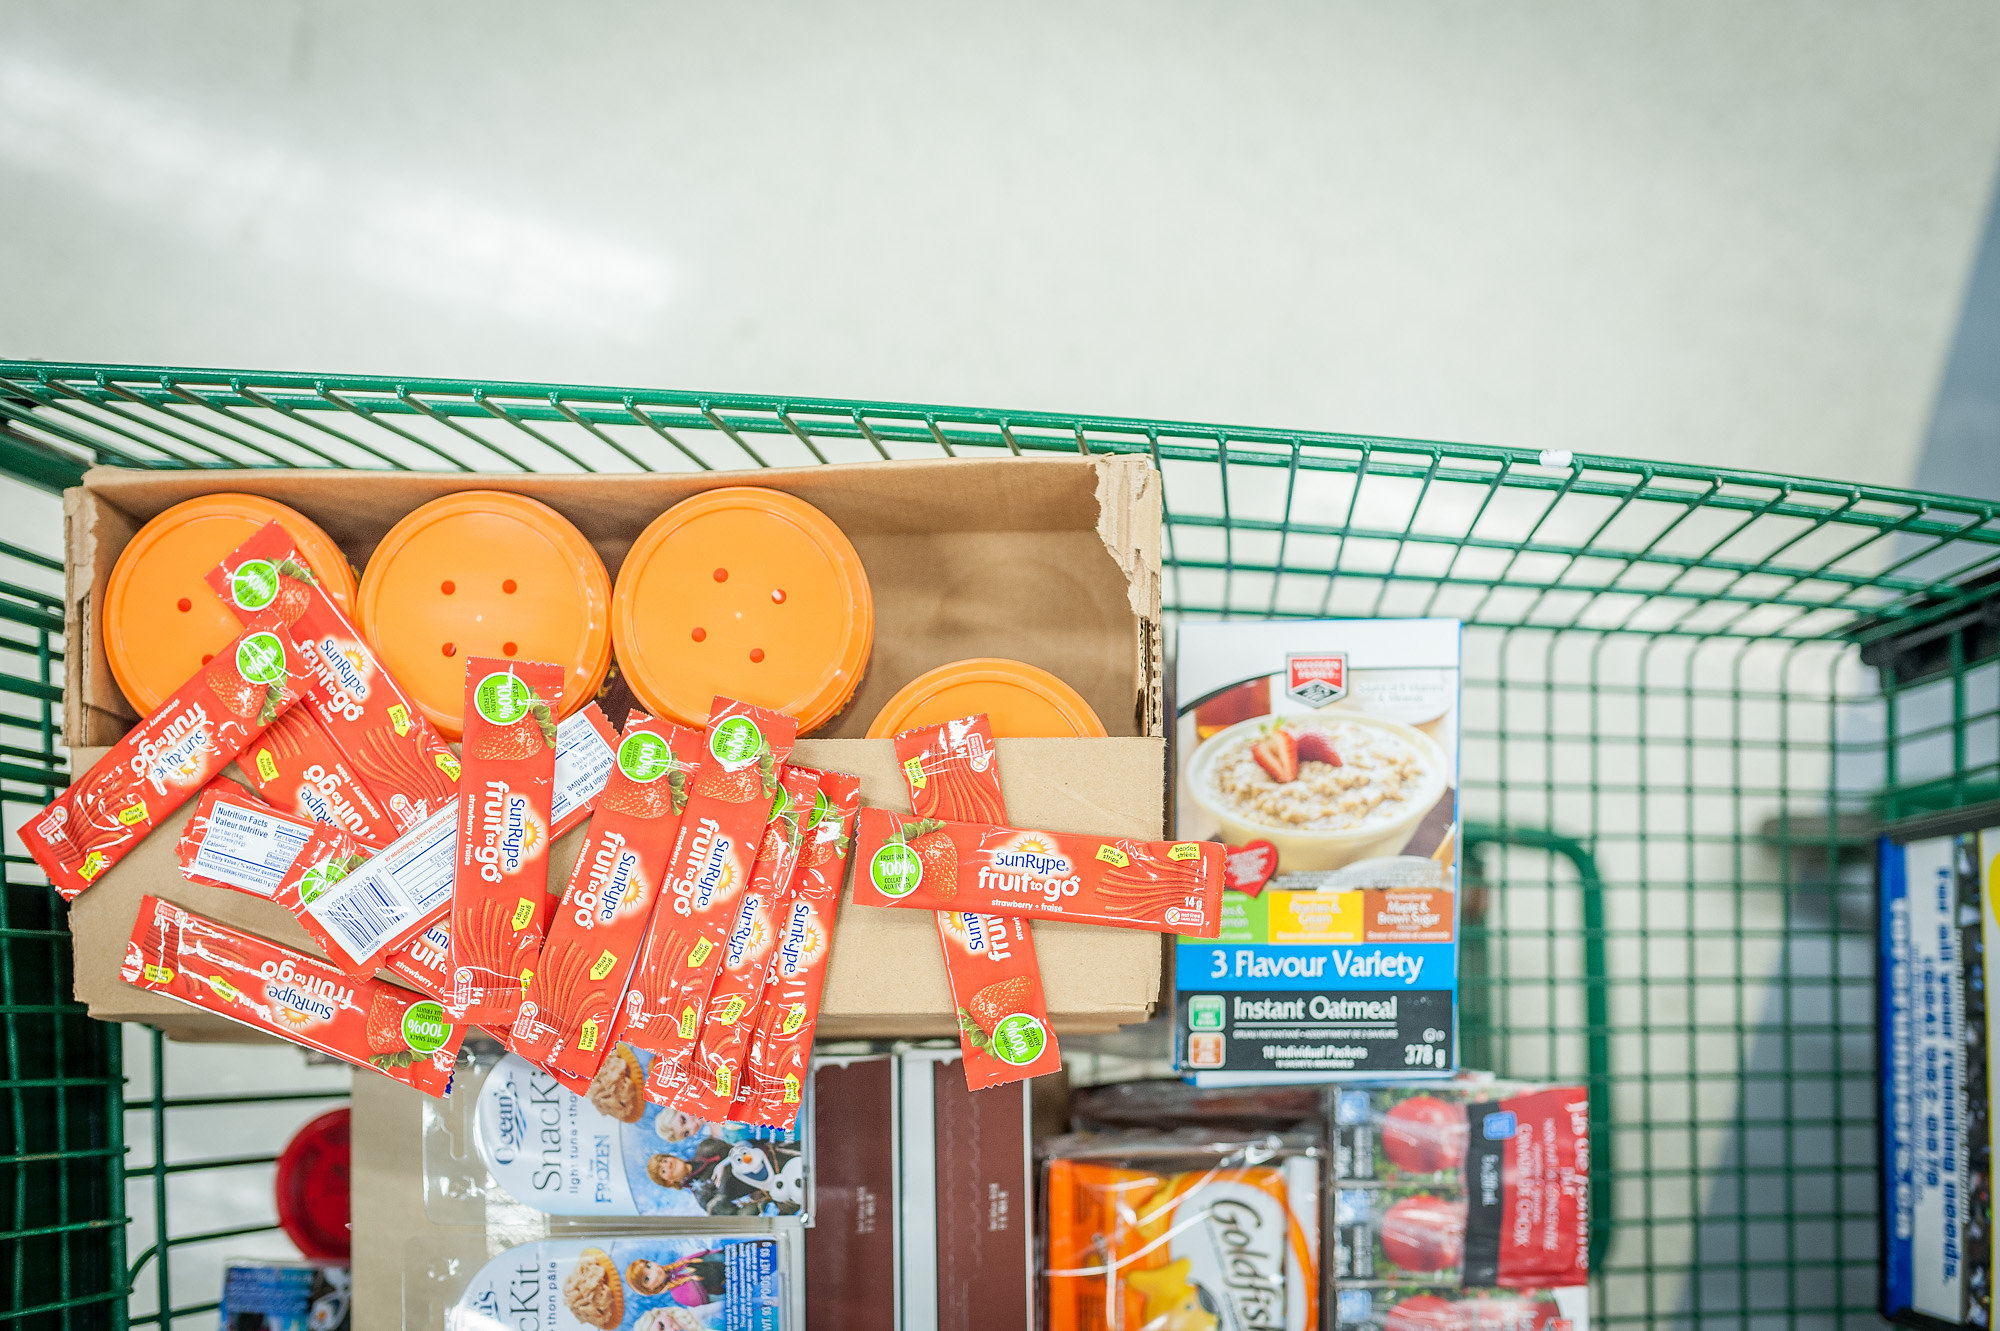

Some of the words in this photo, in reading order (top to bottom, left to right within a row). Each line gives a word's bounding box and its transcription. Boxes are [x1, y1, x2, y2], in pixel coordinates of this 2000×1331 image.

[319, 639, 367, 696] SunRype
[149, 698, 179, 727] strawberry
[318, 704, 333, 722] fraise
[327, 687, 364, 723] go
[497, 682, 512, 719] 100%
[162, 702, 207, 745] fruit
[128, 729, 146, 745] fraise
[729, 723, 746, 762] 100%
[129, 743, 162, 777] go
[623, 752, 631, 768] FRUITS
[630, 742, 639, 768] COLLATION
[637, 739, 654, 778] 100%
[302, 762, 342, 801] go
[335, 763, 351, 783] fraise
[331, 791, 343, 804] to
[352, 785, 380, 819] strawberry
[483, 780, 509, 833] fruit
[214, 815, 238, 829] Valeur
[238, 823, 268, 839] nutritive
[217, 806, 248, 822] Nutrition
[248, 816, 268, 828] Facts
[465, 794, 475, 835] strawberry
[486, 833, 496, 845] to
[502, 798, 525, 867] SunRype
[687, 817, 719, 870] fruit
[464, 844, 473, 865] fraise
[571, 838, 590, 878] strawberry
[590, 830, 625, 884] fruit
[670, 826, 687, 866] strawberry
[1103, 847, 1123, 859] groovy
[1103, 853, 1118, 864] strips
[474, 846, 505, 883] go
[686, 867, 696, 879] to
[696, 838, 729, 906] SunRype
[877, 861, 916, 875] 100%
[996, 852, 1065, 874] SunRype
[348, 875, 371, 894] 61522
[561, 884, 575, 905] fraise
[588, 880, 599, 892] to
[598, 852, 636, 920] SunRype
[662, 872, 673, 893] fraise
[978, 867, 1031, 892] fruit
[1031, 881, 1043, 891] to
[1043, 873, 1080, 902] go
[1936, 867, 1950, 911] For
[571, 889, 603, 929] go
[671, 878, 699, 917] go
[992, 899, 1033, 910] strawberry
[1041, 903, 1063, 913] fraise
[514, 904, 525, 920] strips
[518, 905, 531, 925] groovy
[1378, 912, 1409, 925] Brown
[1412, 912, 1440, 926] Sugar
[727, 897, 758, 962] SunRype
[781, 904, 810, 973] SunRype
[964, 912, 984, 949] SunR
[1938, 924, 1952, 961] all
[402, 934, 446, 971] ruit
[692, 942, 705, 958] strips
[694, 944, 709, 963] groovy
[259, 958, 296, 983] go
[306, 958, 345, 976] strawberry
[395, 960, 432, 987] strawberry
[593, 956, 607, 971] strips
[596, 957, 612, 975] groovy
[1211, 950, 1227, 978] 3
[1236, 951, 1327, 978] Flavour
[1333, 949, 1424, 985] Variety
[268, 985, 333, 1019] SunRype
[302, 976, 354, 1009] fruit
[1939, 972, 1953, 1038] your
[726, 1002, 742, 1020] groovy
[1234, 996, 1306, 1020] Instant
[1309, 995, 1398, 1020] Oatmeal
[405, 1018, 444, 1037] 100%
[409, 1033, 426, 1041] SNACK
[585, 1025, 595, 1048] bandes
[685, 1014, 694, 1036] bandes
[1000, 1029, 1009, 1045] SNACK
[1004, 1020, 1028, 1056] 100%
[1032, 1036, 1040, 1045] AUX
[1275, 1045, 1326, 1059] Individual
[1326, 1045, 1368, 1059] Packets
[1405, 1044, 1433, 1066] 378
[1435, 1049, 1446, 1069] g
[494, 1081, 516, 1165] Ocean's
[1941, 1050, 1955, 1172] running
[532, 1072, 562, 1192] SnacK
[594, 1135, 611, 1203] FROZEN
[1942, 1181, 1957, 1284] needs.
[760, 1258, 770, 1273] NET
[761, 1274, 771, 1298] POIDS
[547, 1295, 557, 1325] thon
